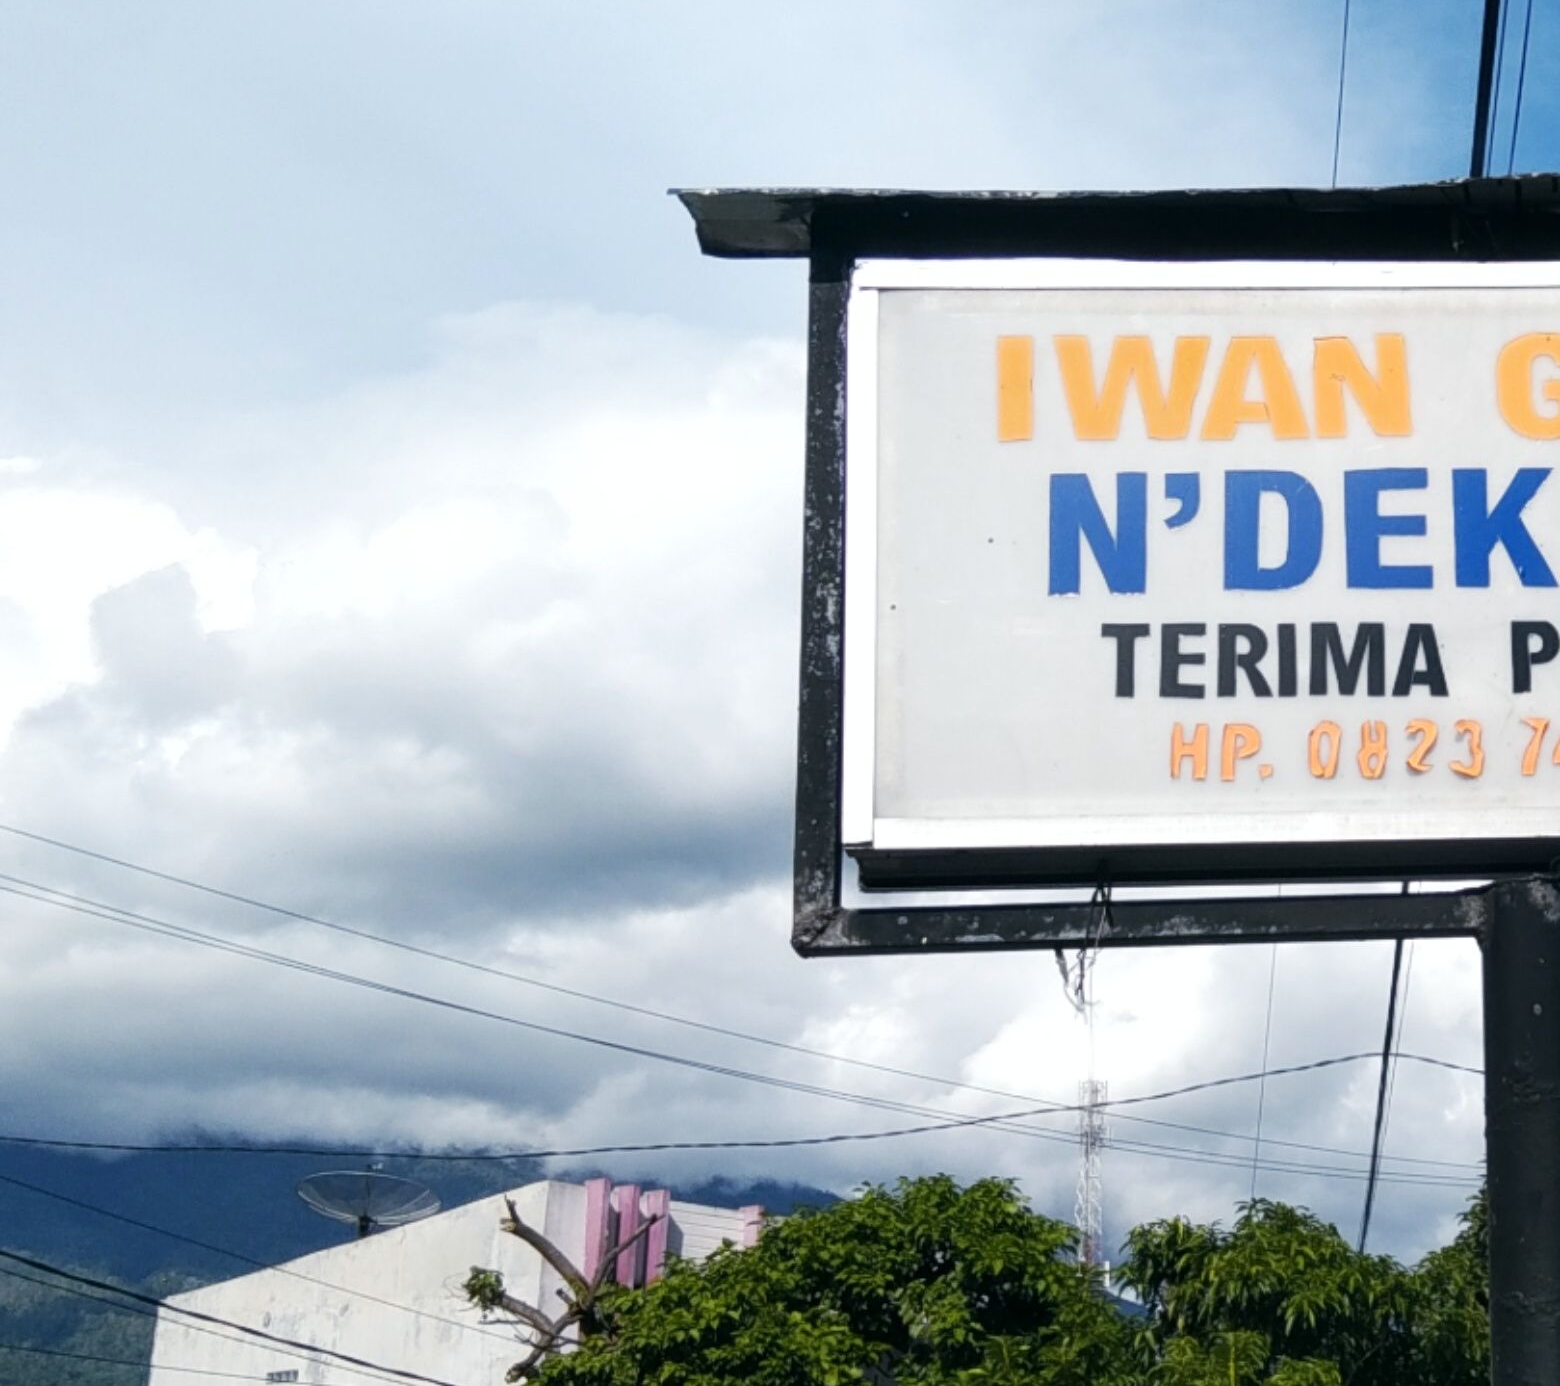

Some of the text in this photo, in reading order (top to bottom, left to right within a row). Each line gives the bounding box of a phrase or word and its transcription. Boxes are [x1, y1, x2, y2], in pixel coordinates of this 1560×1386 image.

[997, 333, 1413, 441] IWAN
[1047, 466, 1560, 596] N'DEK
[1101, 621, 1449, 699] TERIMA
[1169, 721, 1274, 782] HP.
[1306, 719, 1484, 781] 0823
